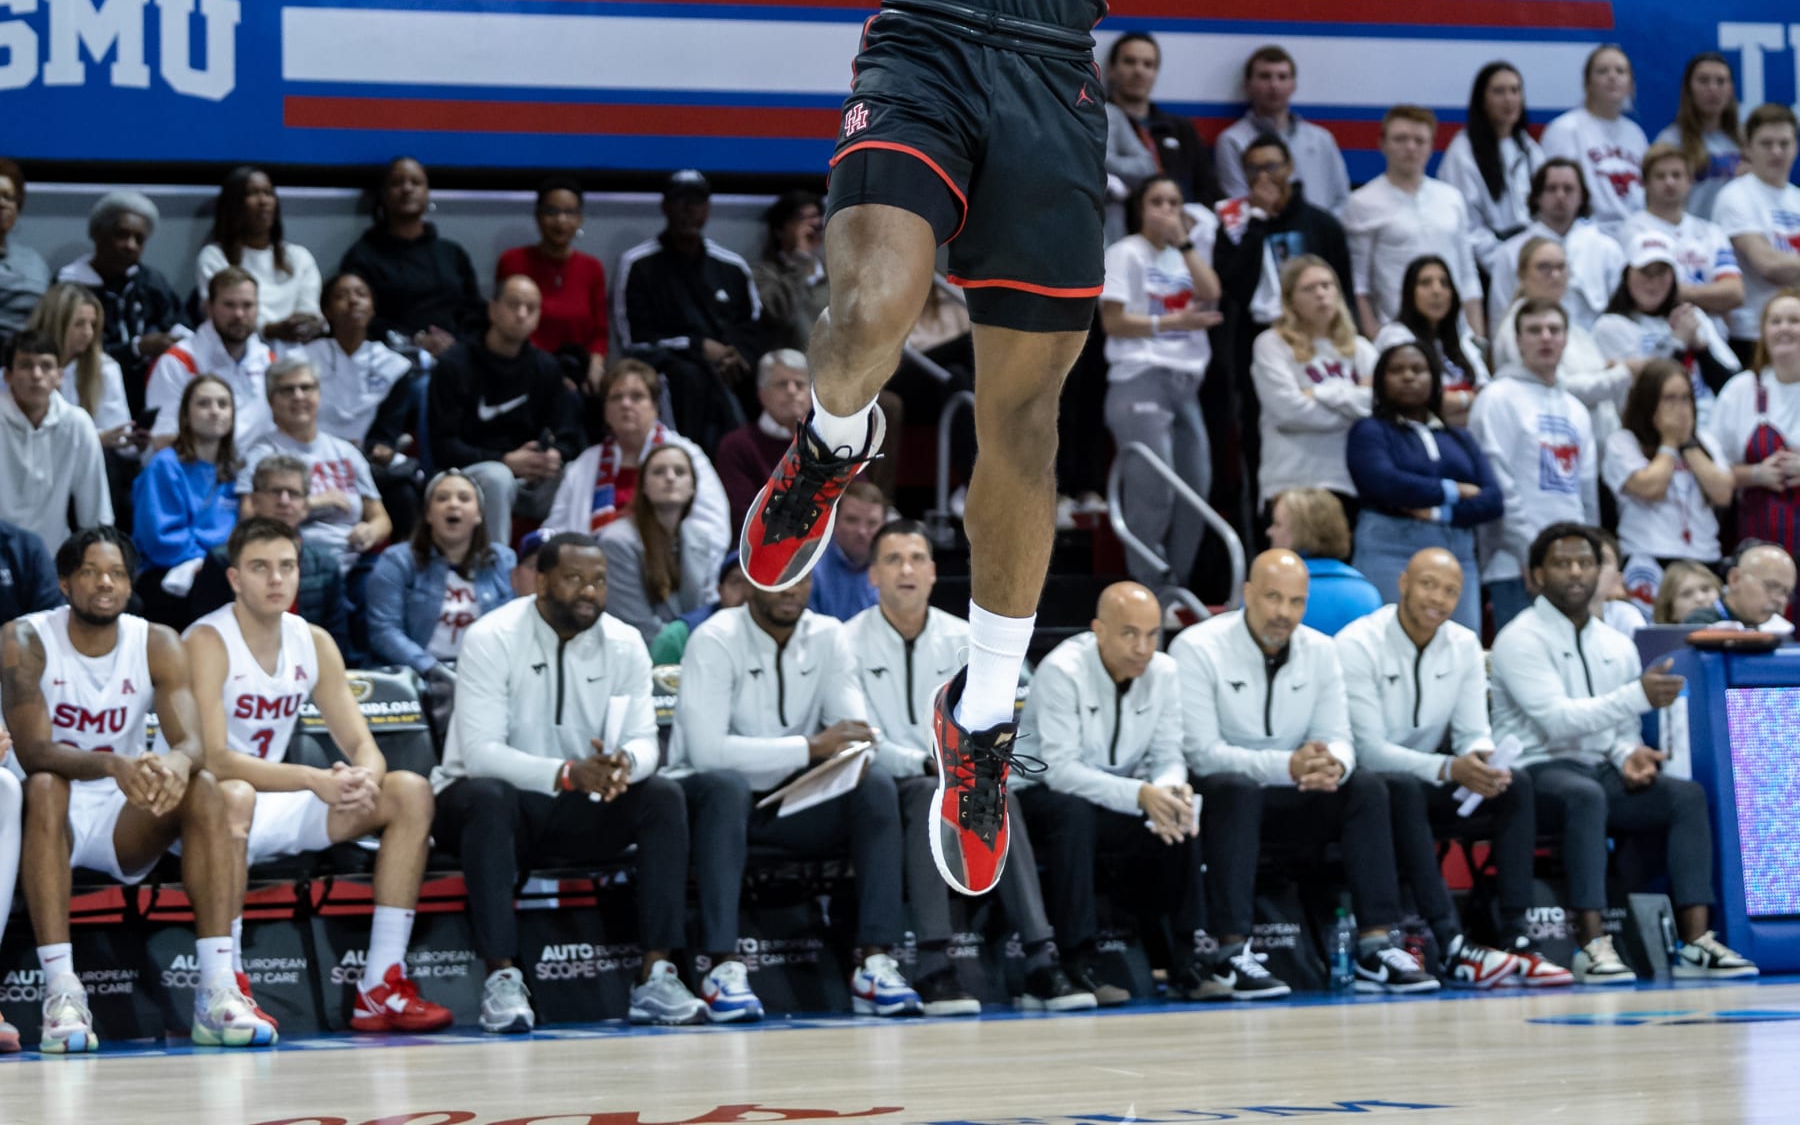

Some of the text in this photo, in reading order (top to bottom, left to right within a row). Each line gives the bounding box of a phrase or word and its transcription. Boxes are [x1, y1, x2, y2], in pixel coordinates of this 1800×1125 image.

[233, 693, 302, 720] SMU
[53, 702, 128, 733] SMU
[1525, 907, 1566, 922] UTO
[1527, 923, 1567, 940] OPE
[541, 943, 594, 962] AUTO
[170, 955, 200, 970] AU
[243, 957, 308, 970] UROPEAN
[433, 963, 469, 977] CARE
[535, 960, 597, 980] SCOPE
[3, 970, 47, 985] AUT
[160, 970, 200, 988] SCO
[263, 970, 299, 984] CARE
[97, 982, 134, 995] CARE
